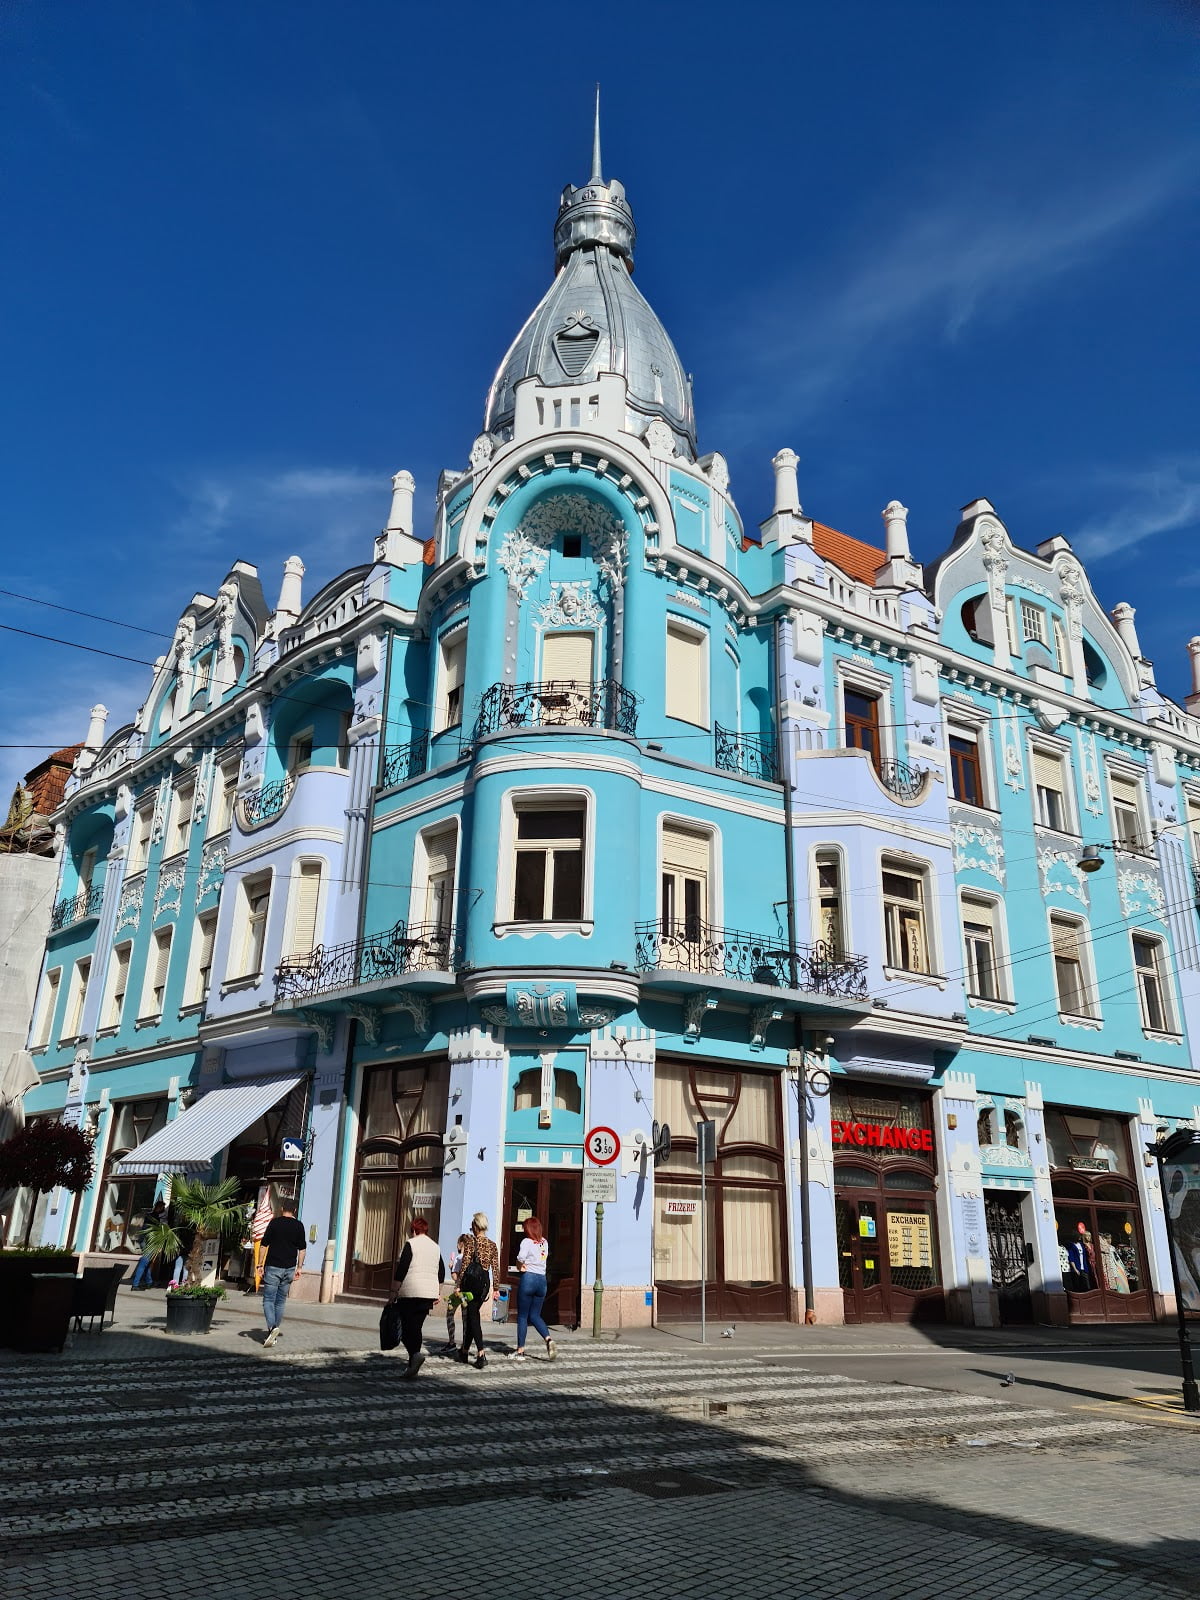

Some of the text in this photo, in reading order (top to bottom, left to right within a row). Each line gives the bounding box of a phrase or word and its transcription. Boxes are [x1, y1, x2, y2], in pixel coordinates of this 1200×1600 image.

[831, 1119, 933, 1151] EXCHANGE
[668, 1202, 697, 1212] FRIZERIE
[891, 1216, 926, 1225] EXCHANGE
